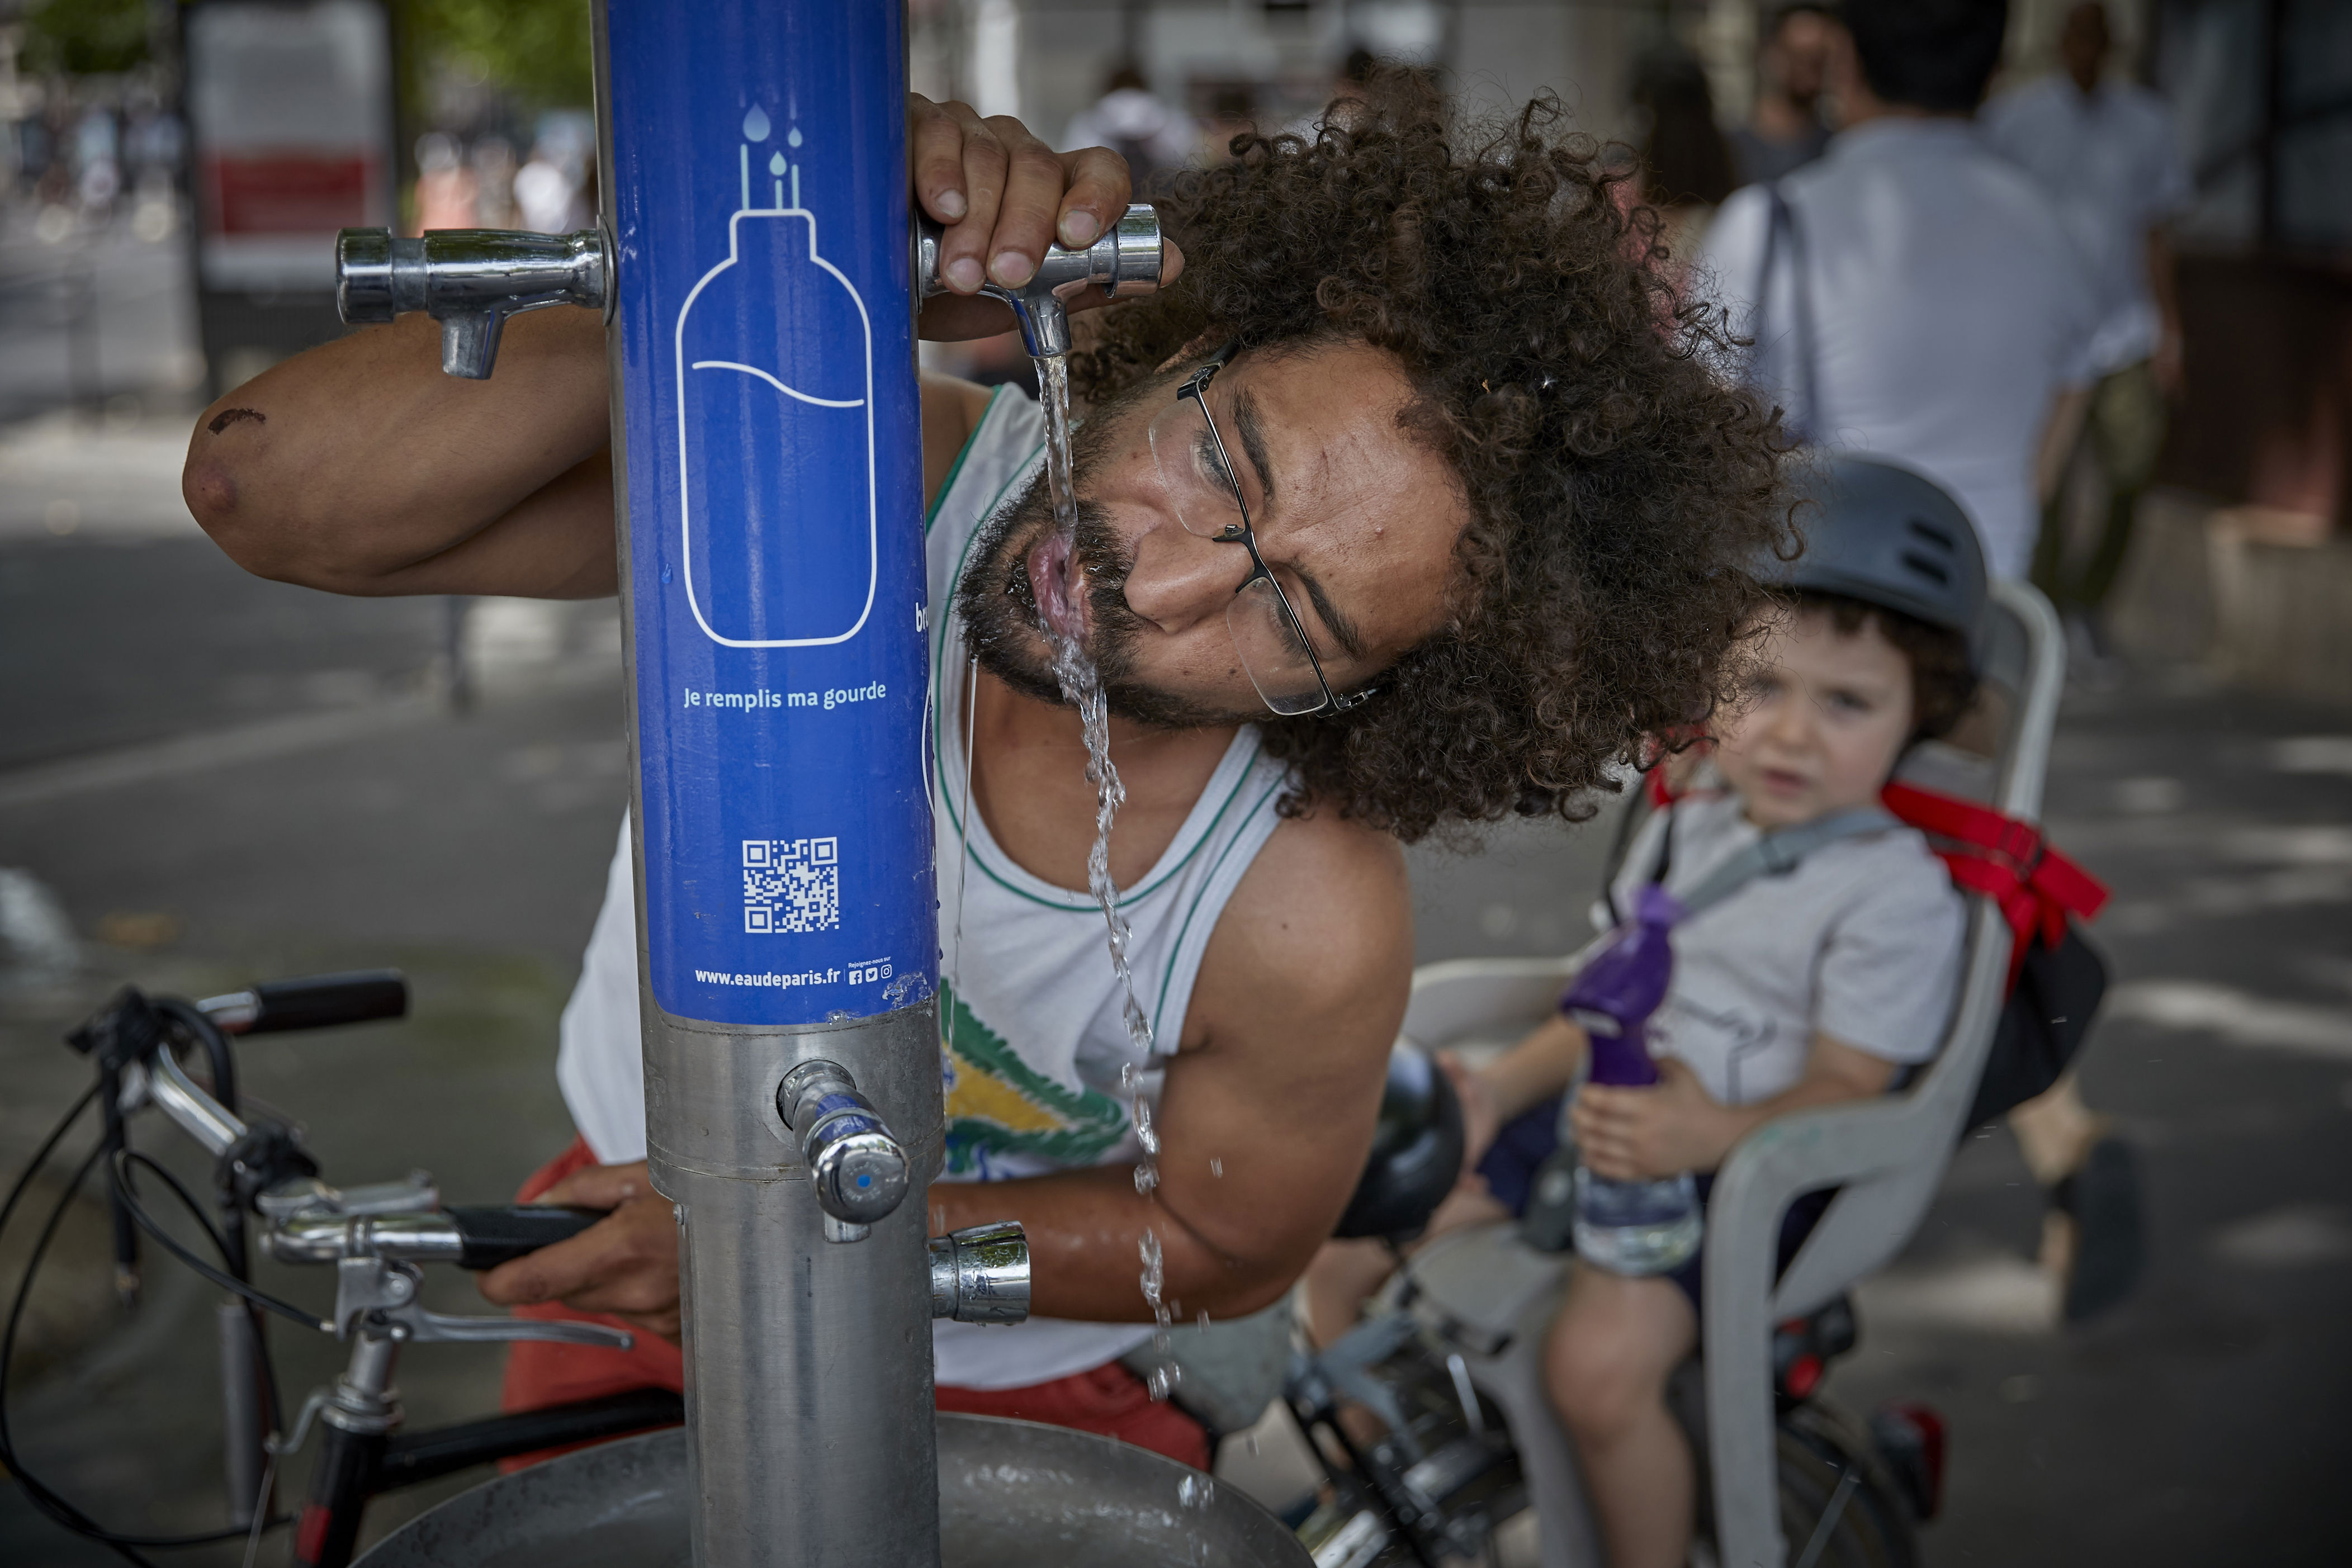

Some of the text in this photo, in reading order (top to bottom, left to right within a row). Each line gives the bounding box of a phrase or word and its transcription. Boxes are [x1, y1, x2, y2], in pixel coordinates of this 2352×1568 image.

[684, 681, 886, 713] Je remplis ma gourde
[848, 958, 883, 969] Rejoignez-nous
[695, 968, 841, 989] www.eaudeparis.fr
